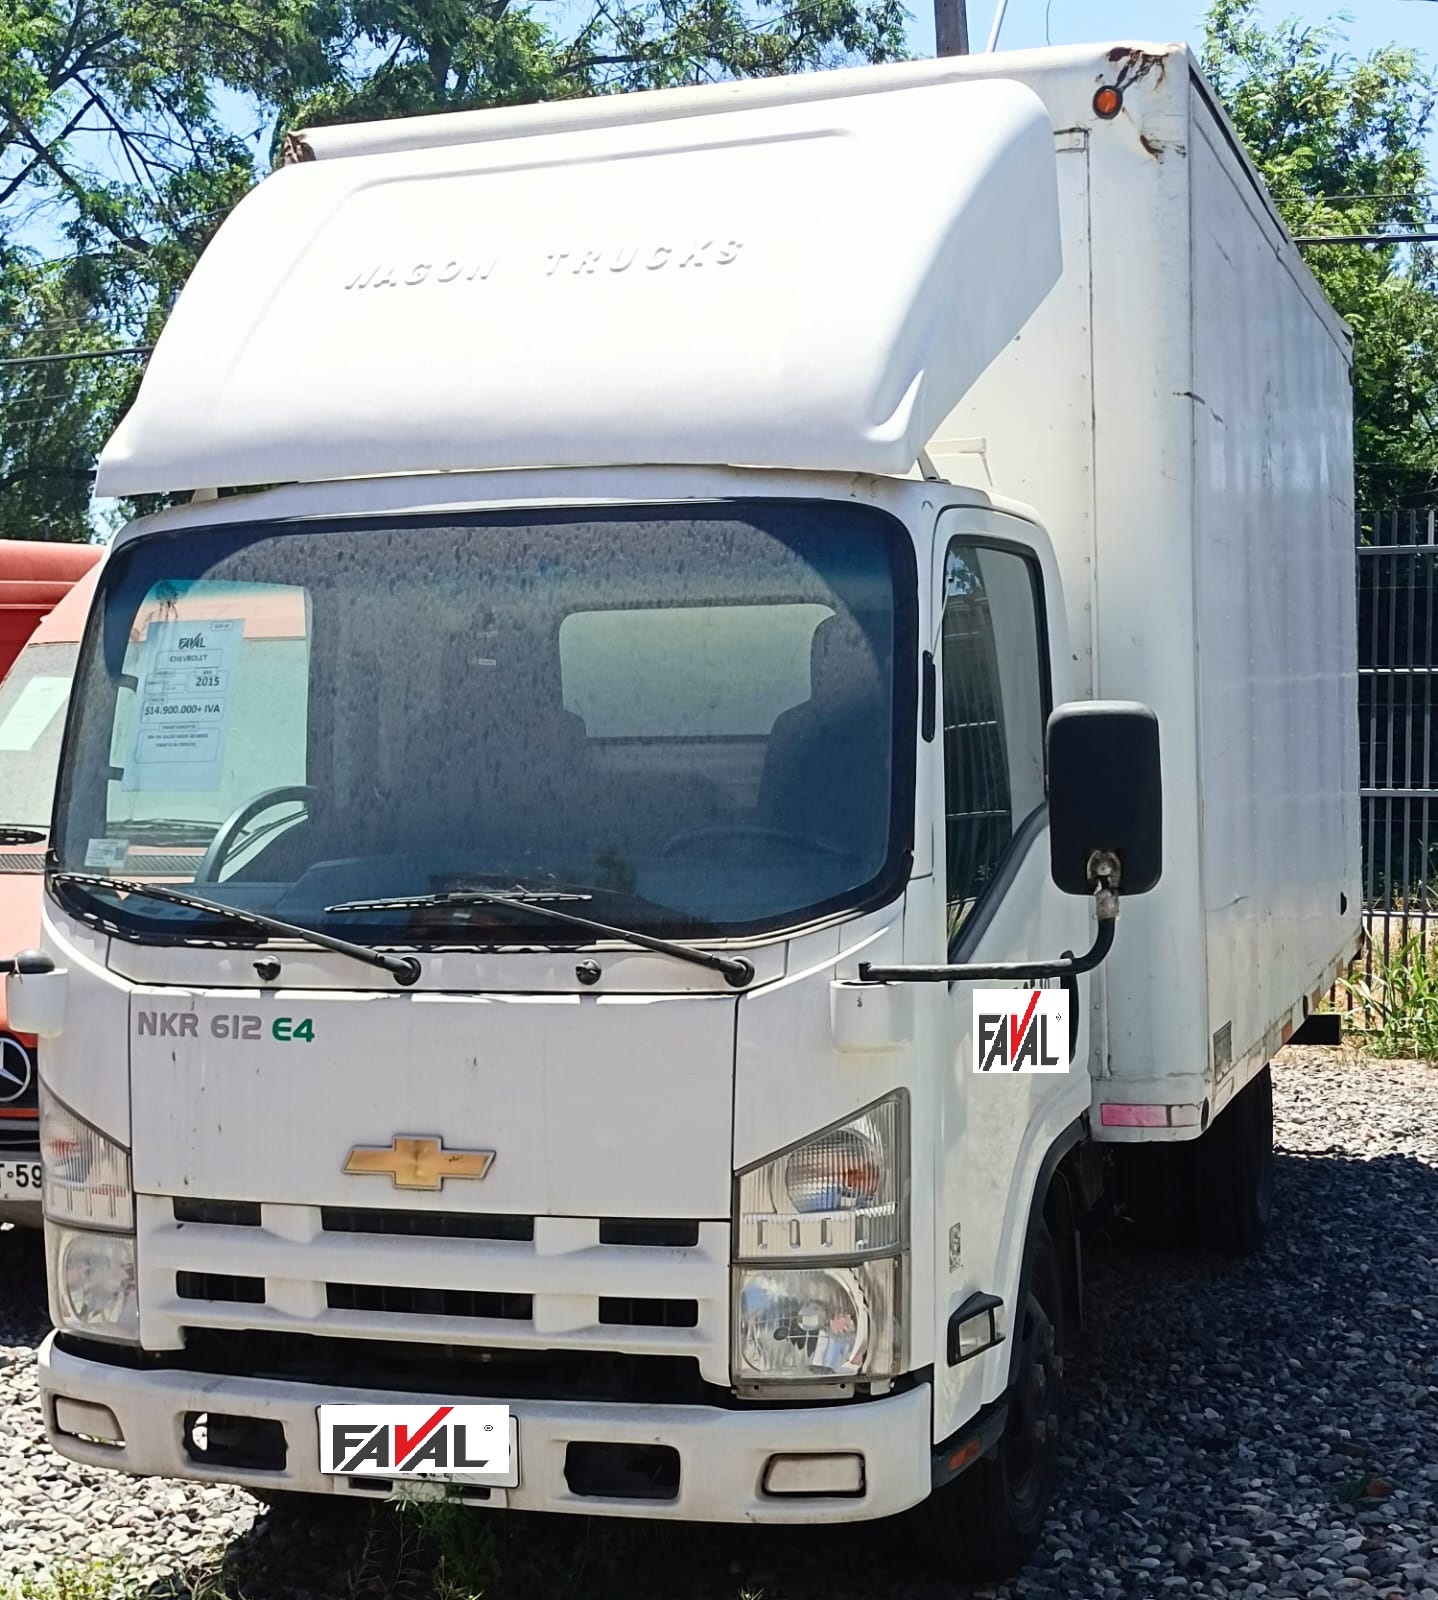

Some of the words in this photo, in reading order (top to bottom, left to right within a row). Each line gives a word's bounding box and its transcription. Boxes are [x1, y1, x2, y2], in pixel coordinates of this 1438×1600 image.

[545, 239, 744, 278] TRUCKS
[178, 632, 206, 649] FAVAL
[169, 654, 208, 663] CHEVROLET
[195, 676, 220, 687] 2015
[204, 704, 220, 713] IVA
[138, 1011, 198, 1037] NKR
[210, 1014, 262, 1040] 612
[272, 1017, 315, 1042] E4
